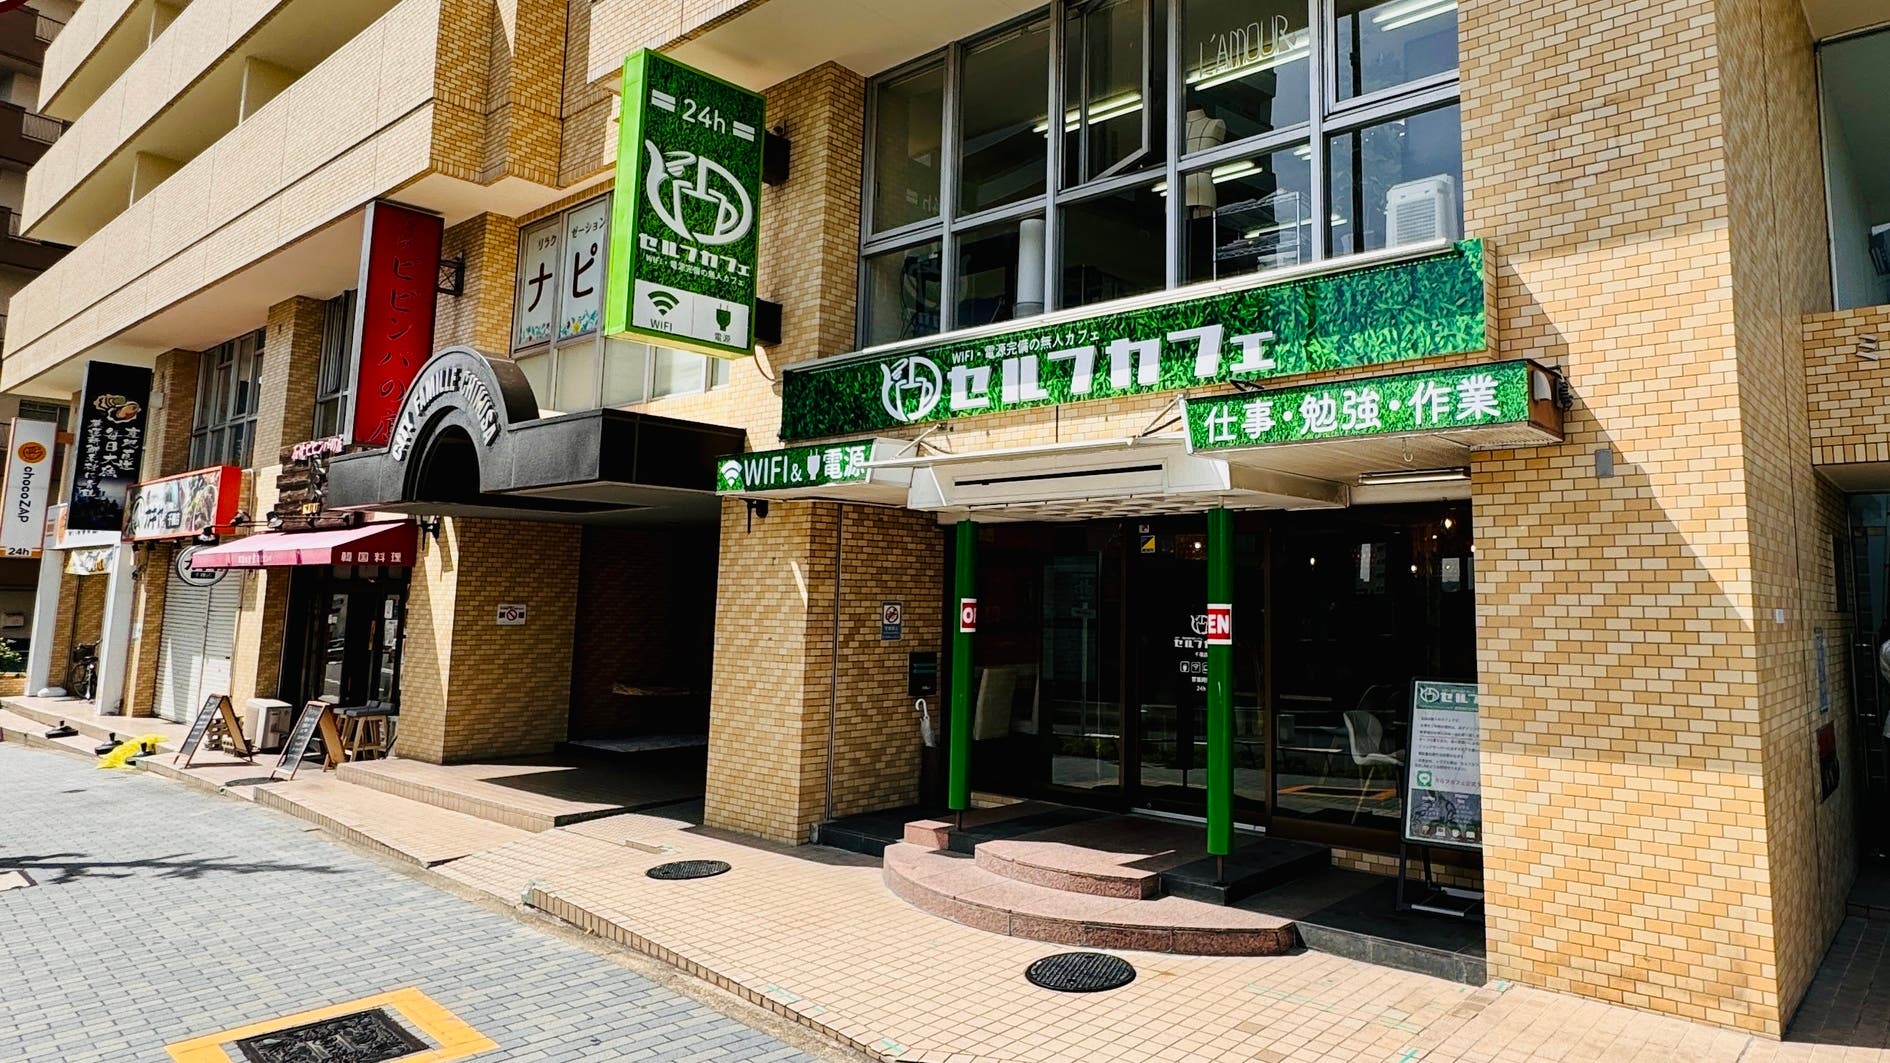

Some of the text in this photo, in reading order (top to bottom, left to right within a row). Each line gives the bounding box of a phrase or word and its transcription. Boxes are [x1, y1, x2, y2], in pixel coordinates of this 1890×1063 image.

[1200, 14, 1295, 79] L'AMOUR
[682, 98, 726, 135] 24h
[639, 233, 750, 277] セルフカフェ
[650, 318, 673, 332] WIFI
[947, 323, 1277, 411] セルフカフェ
[414, 368, 461, 416] FAMILLE
[1203, 375, 1501, 443] 仕事・勉強・作業
[744, 455, 788, 487] WIFI
[822, 446, 866, 479] 電源
[17, 466, 36, 523] chocoZAP
[8, 547, 30, 557] 24h
[341, 552, 402, 563] 韓国料理
